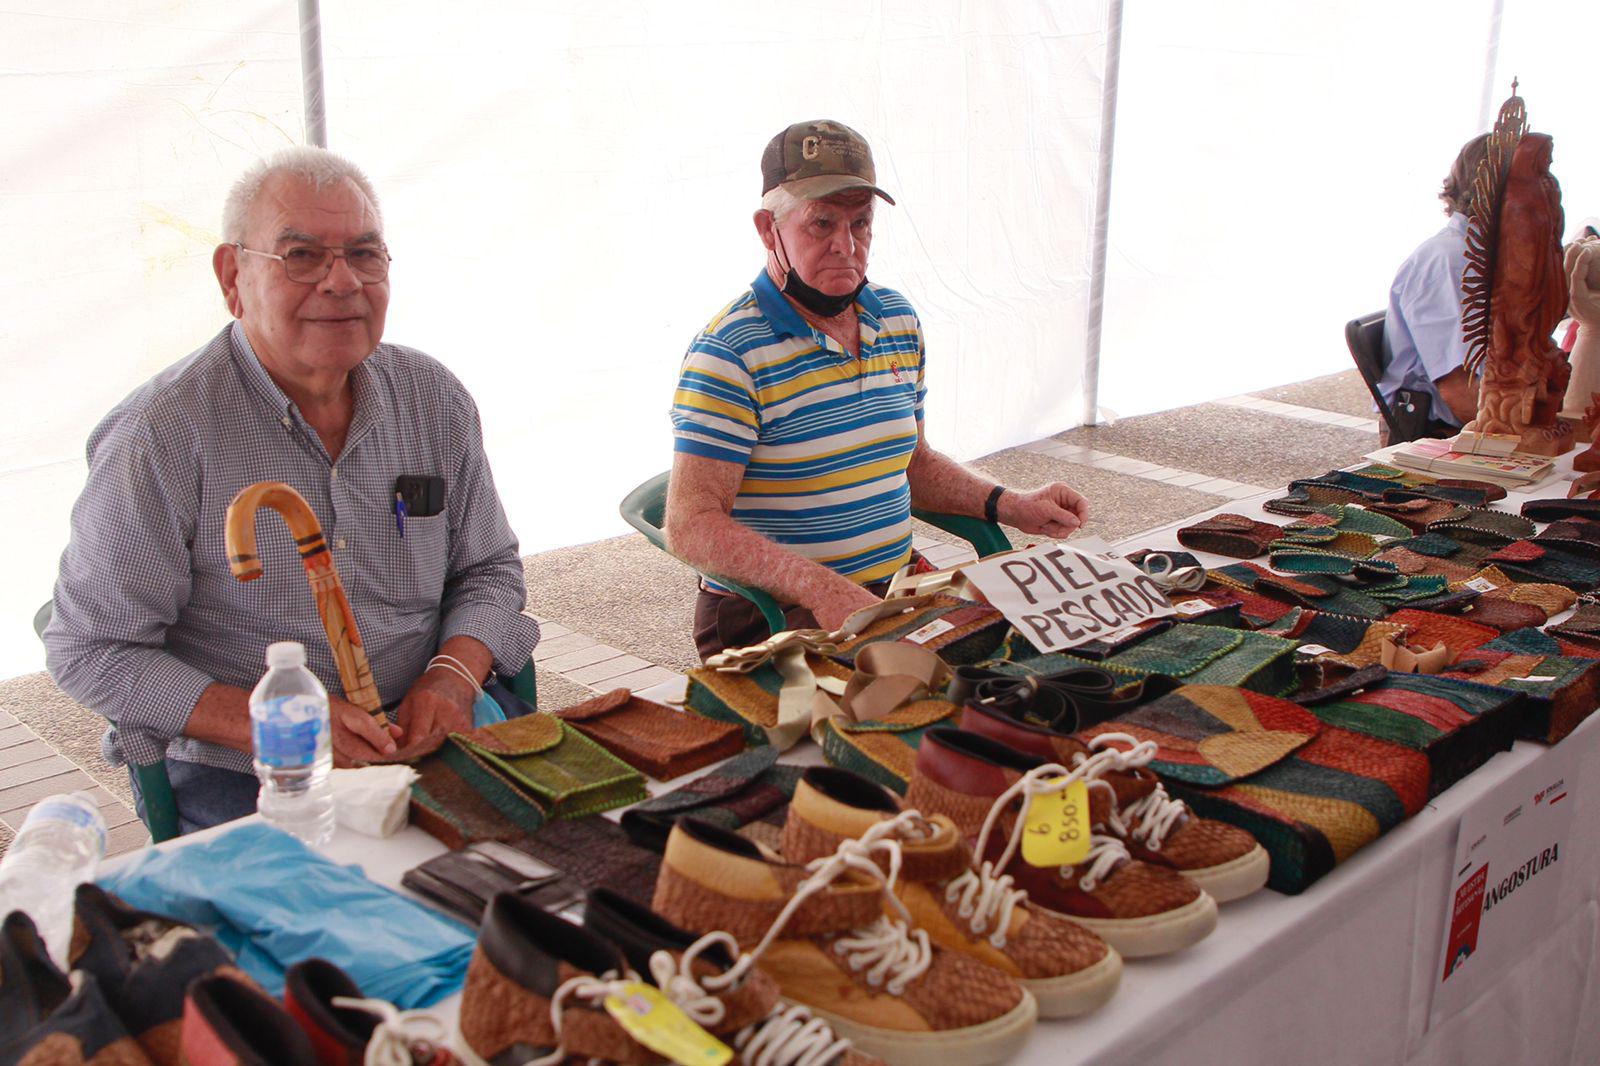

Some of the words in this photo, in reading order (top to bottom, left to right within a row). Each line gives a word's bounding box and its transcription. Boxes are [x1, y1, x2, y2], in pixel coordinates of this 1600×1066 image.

[1000, 549, 1118, 604] PIEL
[1096, 551, 1119, 561] DE
[1021, 574, 1171, 647] PESCADO
[1482, 843, 1558, 915] ANGOSTURA
